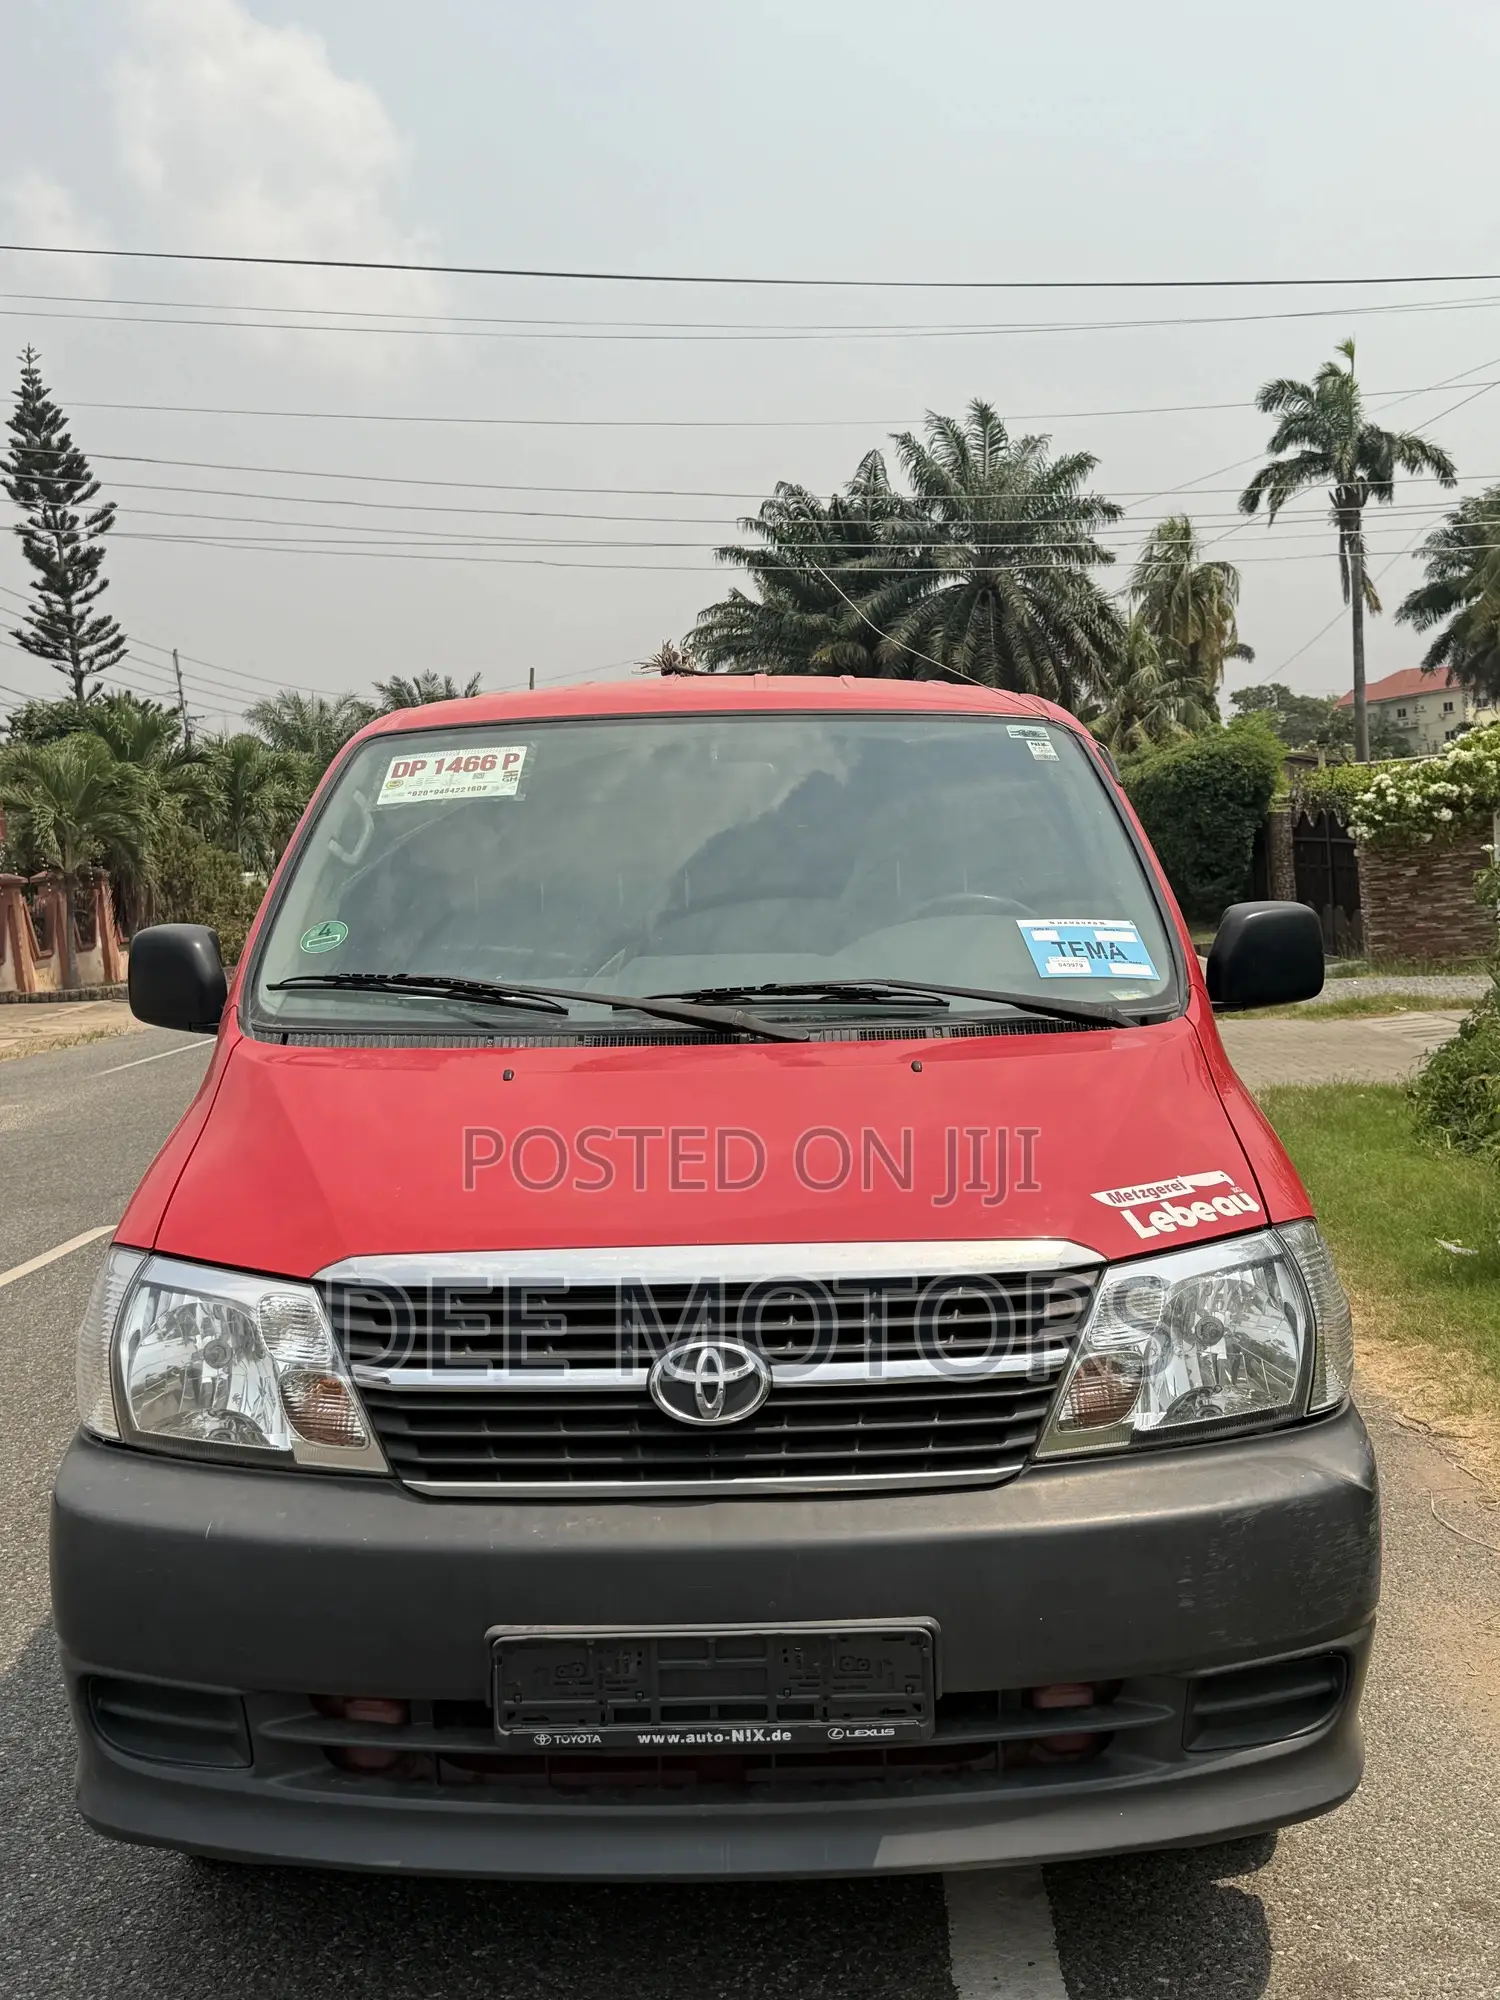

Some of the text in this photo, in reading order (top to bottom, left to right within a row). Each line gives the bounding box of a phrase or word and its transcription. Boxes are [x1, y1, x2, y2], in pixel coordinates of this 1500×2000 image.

[391, 753, 520, 778] DP 1466 P
[318, 923, 332, 936] 4
[1051, 941, 1128, 960] TEMA
[1106, 1180, 1188, 1204] Metzgerei
[1119, 1192, 1261, 1239] Lebeau
[553, 1734, 602, 1745] TOYOTA
[637, 1729, 792, 1744] www.auto-NIX.de
[846, 1728, 895, 1737] LEXUS
